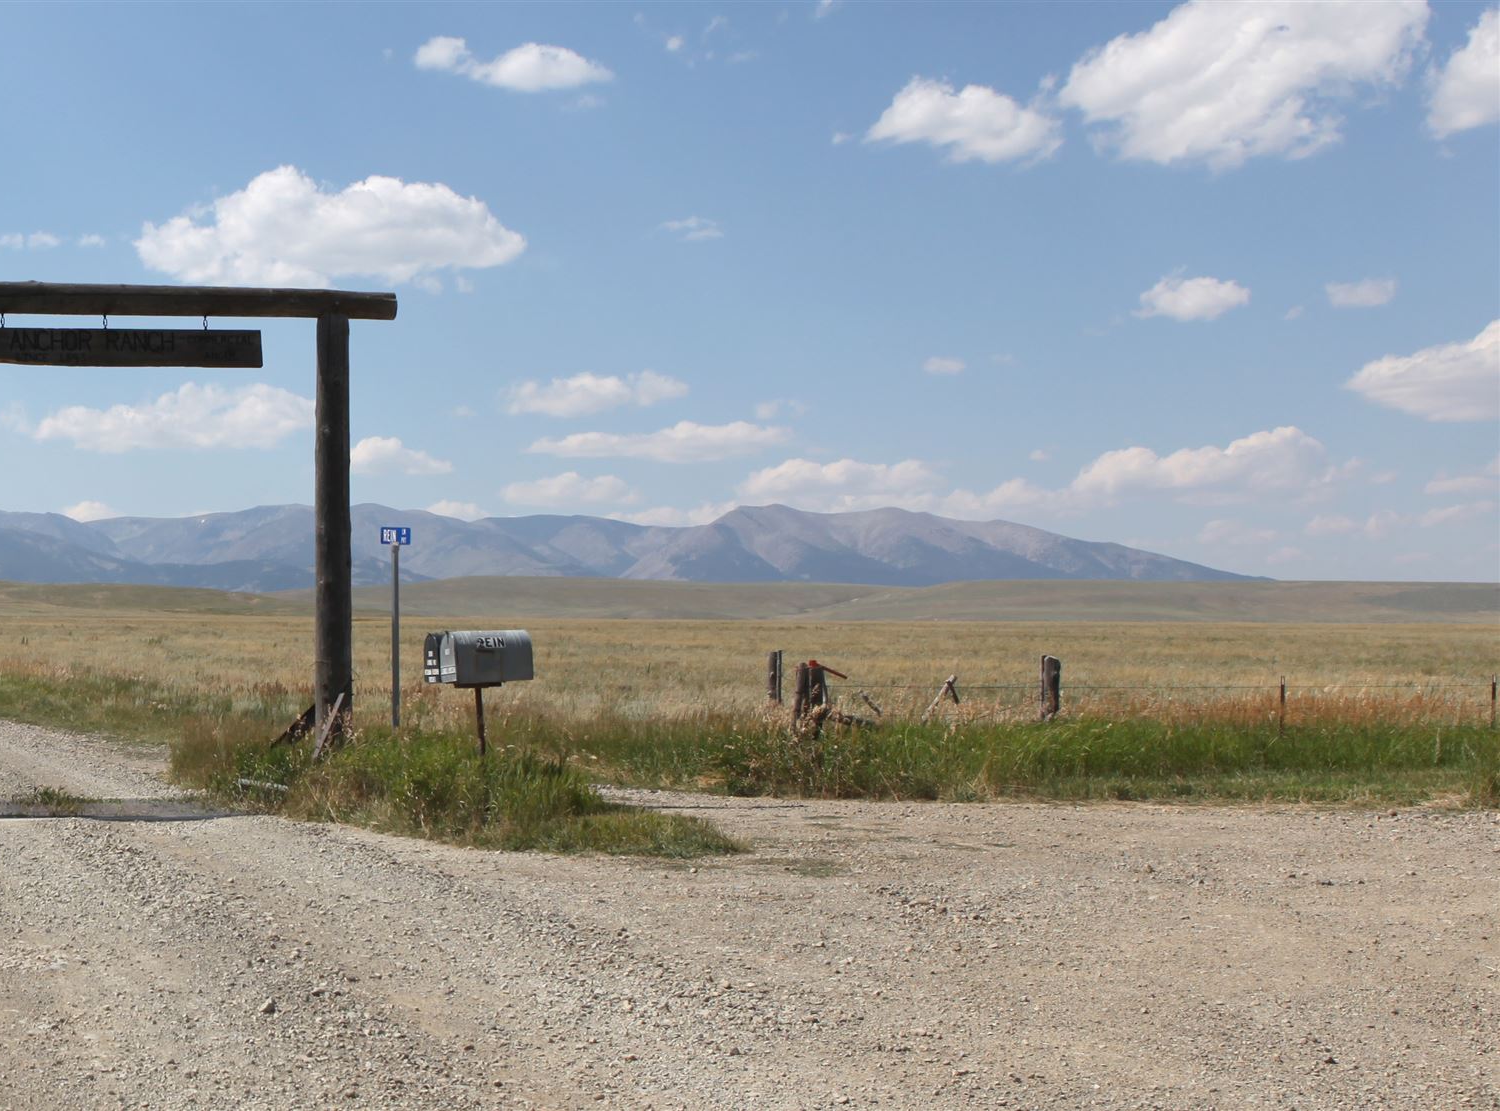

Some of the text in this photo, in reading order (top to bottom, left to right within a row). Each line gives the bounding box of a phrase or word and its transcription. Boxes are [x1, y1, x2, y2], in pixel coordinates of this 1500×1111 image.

[9, 330, 92, 352] ANCHOR
[105, 331, 175, 353] RANCH
[383, 529, 397, 542] REIN
[476, 637, 505, 648] REIN
